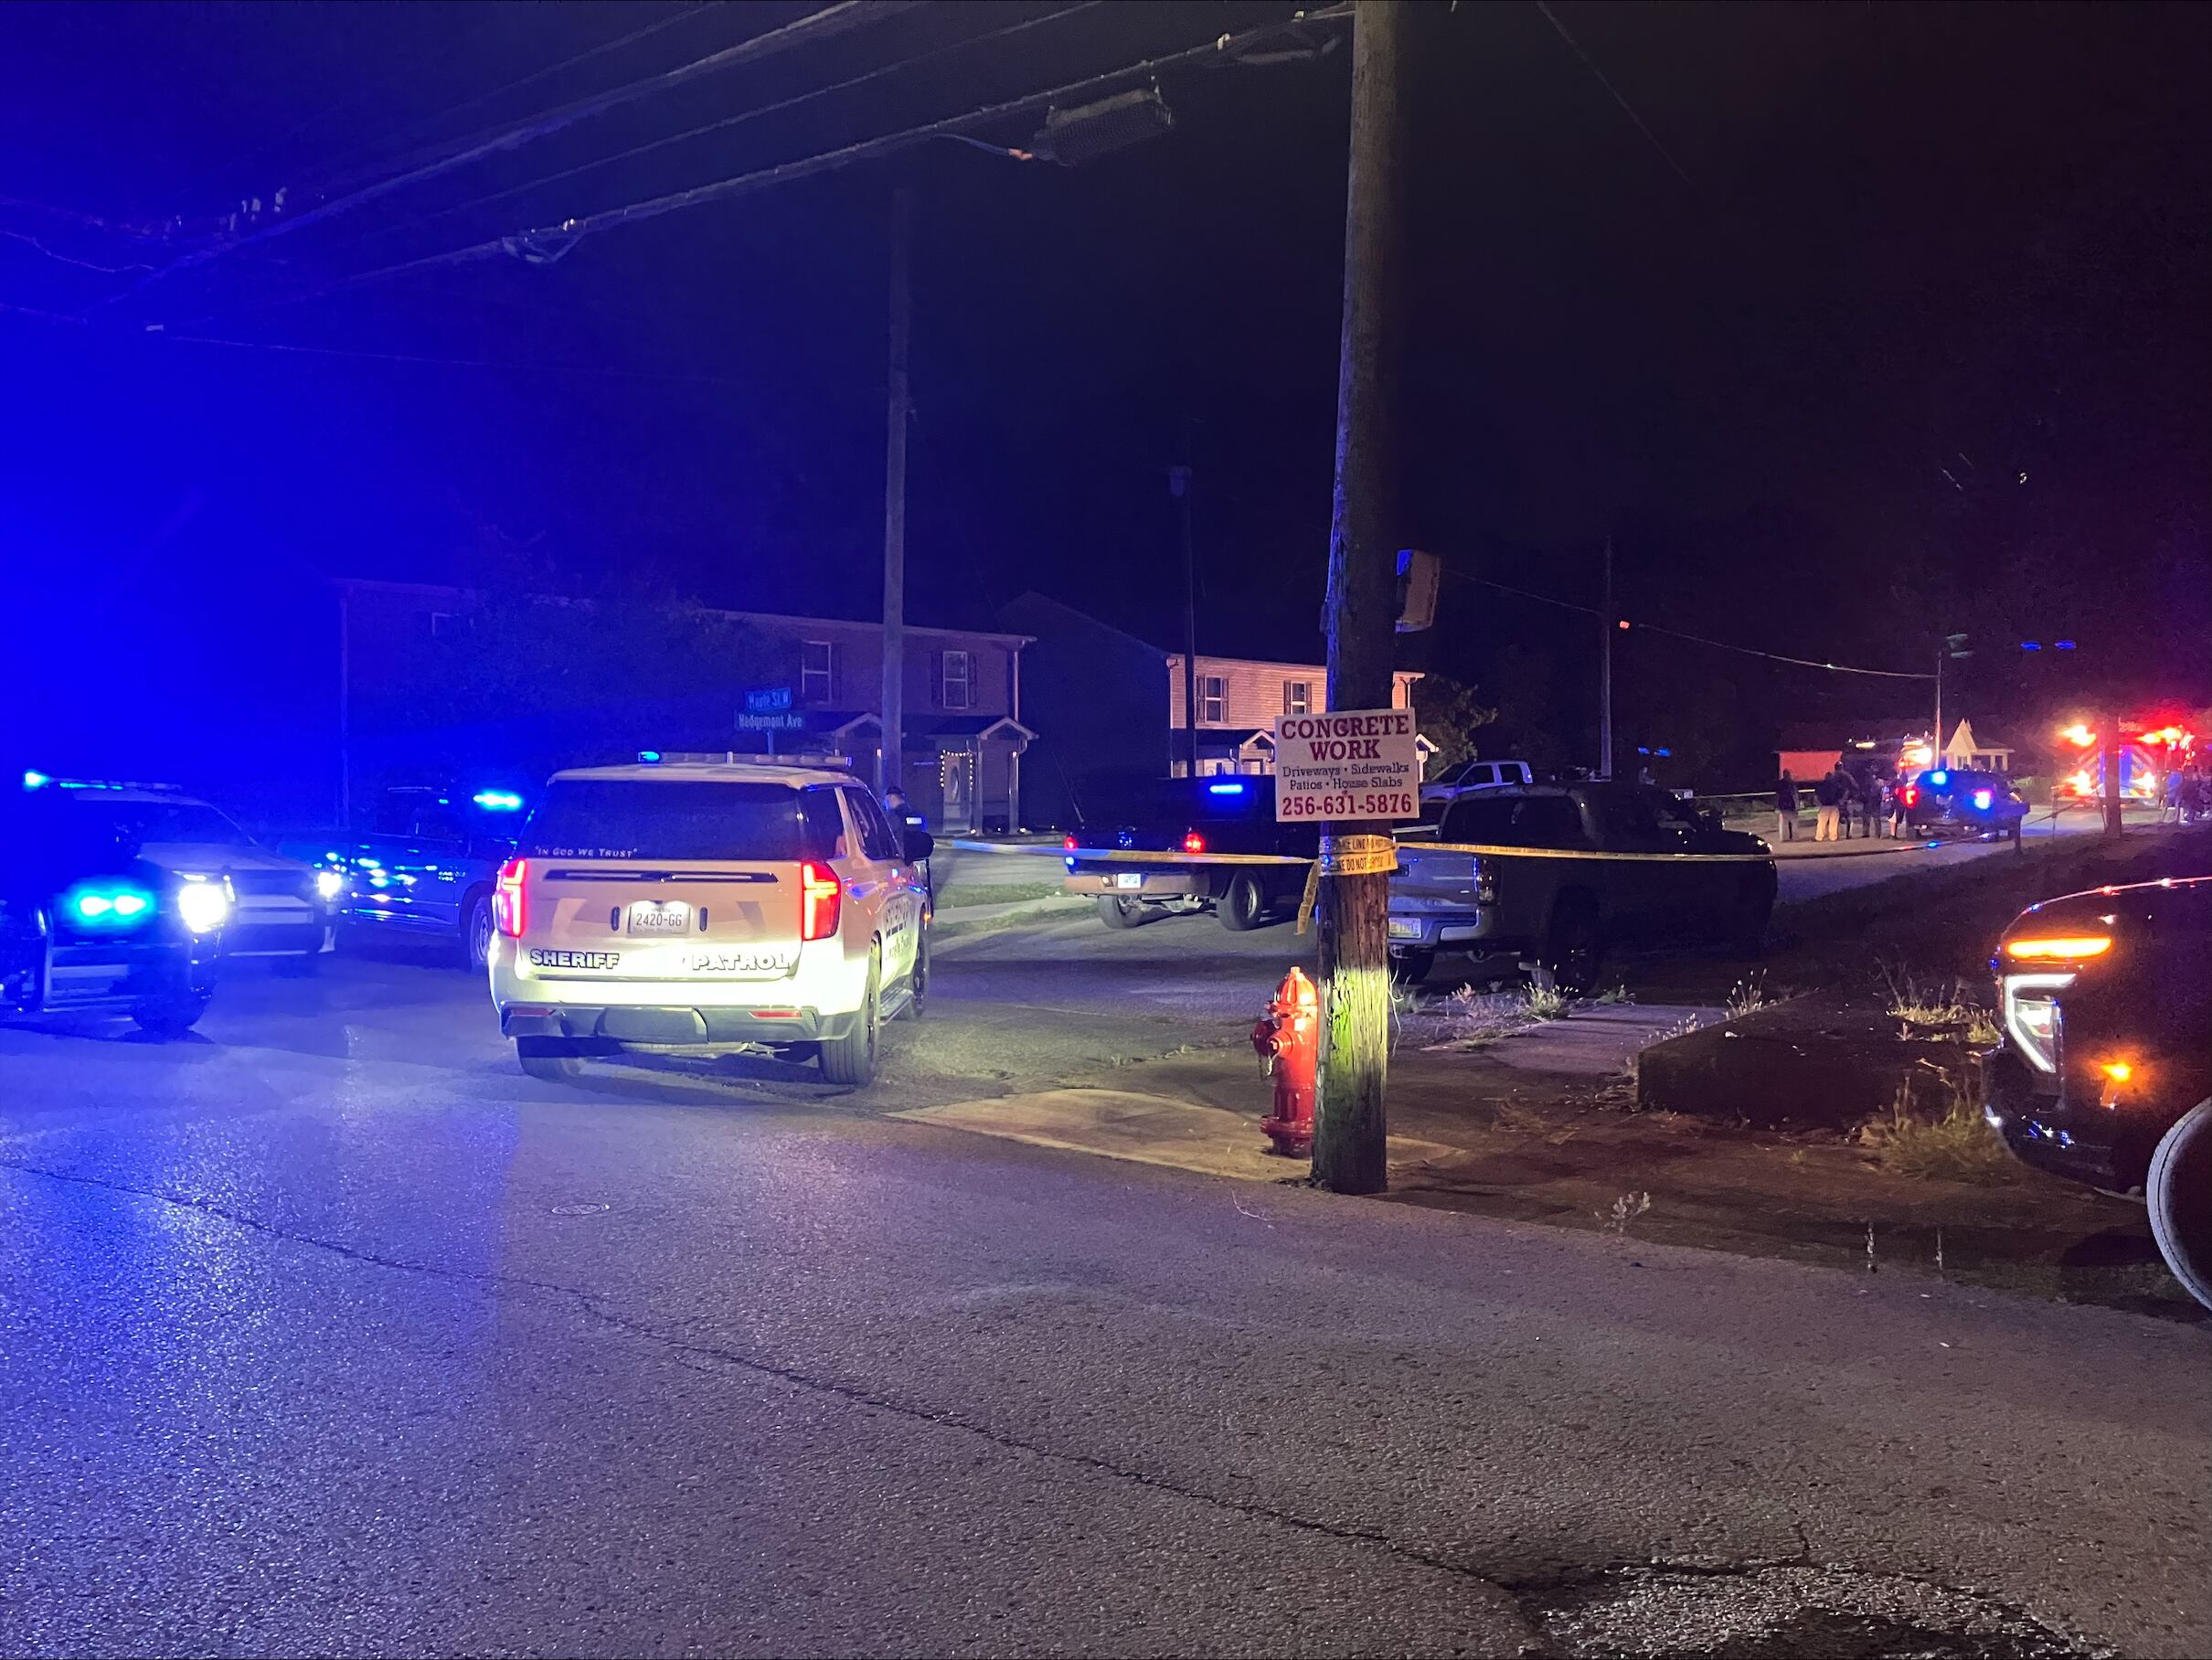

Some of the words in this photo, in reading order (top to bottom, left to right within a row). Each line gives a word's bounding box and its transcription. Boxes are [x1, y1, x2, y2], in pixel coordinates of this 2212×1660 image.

[786, 713, 803, 728] Ave
[1310, 739, 1381, 761] WORK
[1282, 766, 1341, 778] Driveways
[1351, 761, 1409, 775] Sidewalks
[1290, 780, 1323, 791] Patios
[1333, 778, 1368, 790] House
[1371, 776, 1402, 788] Slabs
[1282, 793, 1412, 816] 256-631-5876
[635, 912, 683, 927] 2420-GG
[529, 948, 620, 970] SHERIFF
[692, 952, 790, 971] PATROL
